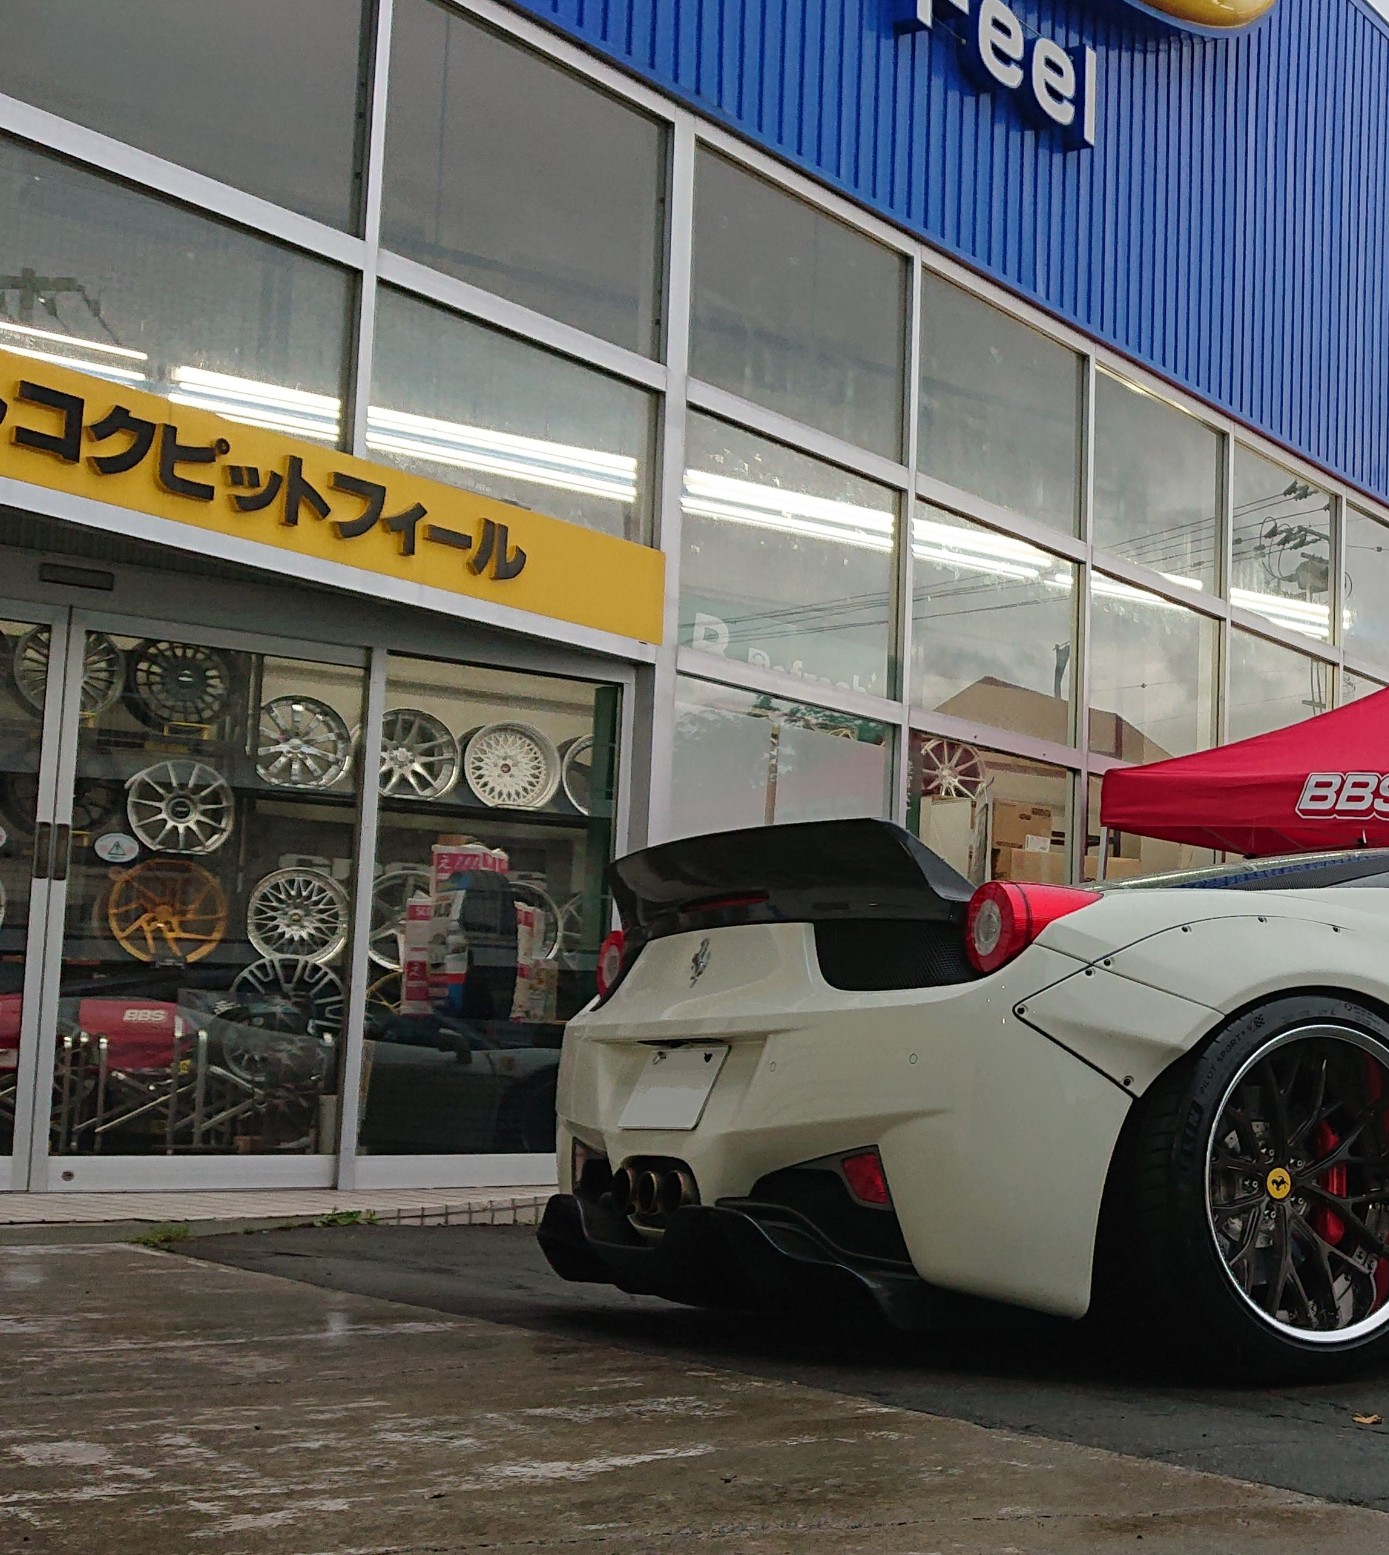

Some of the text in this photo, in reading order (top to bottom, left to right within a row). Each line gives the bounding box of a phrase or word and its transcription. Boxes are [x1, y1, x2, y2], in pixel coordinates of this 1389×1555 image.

[916, 0, 1097, 147] eel
[0, 380, 527, 580] コクピットフィール
[124, 1009, 167, 1023] BBS
[1216, 1034, 1242, 1064] SPORT
